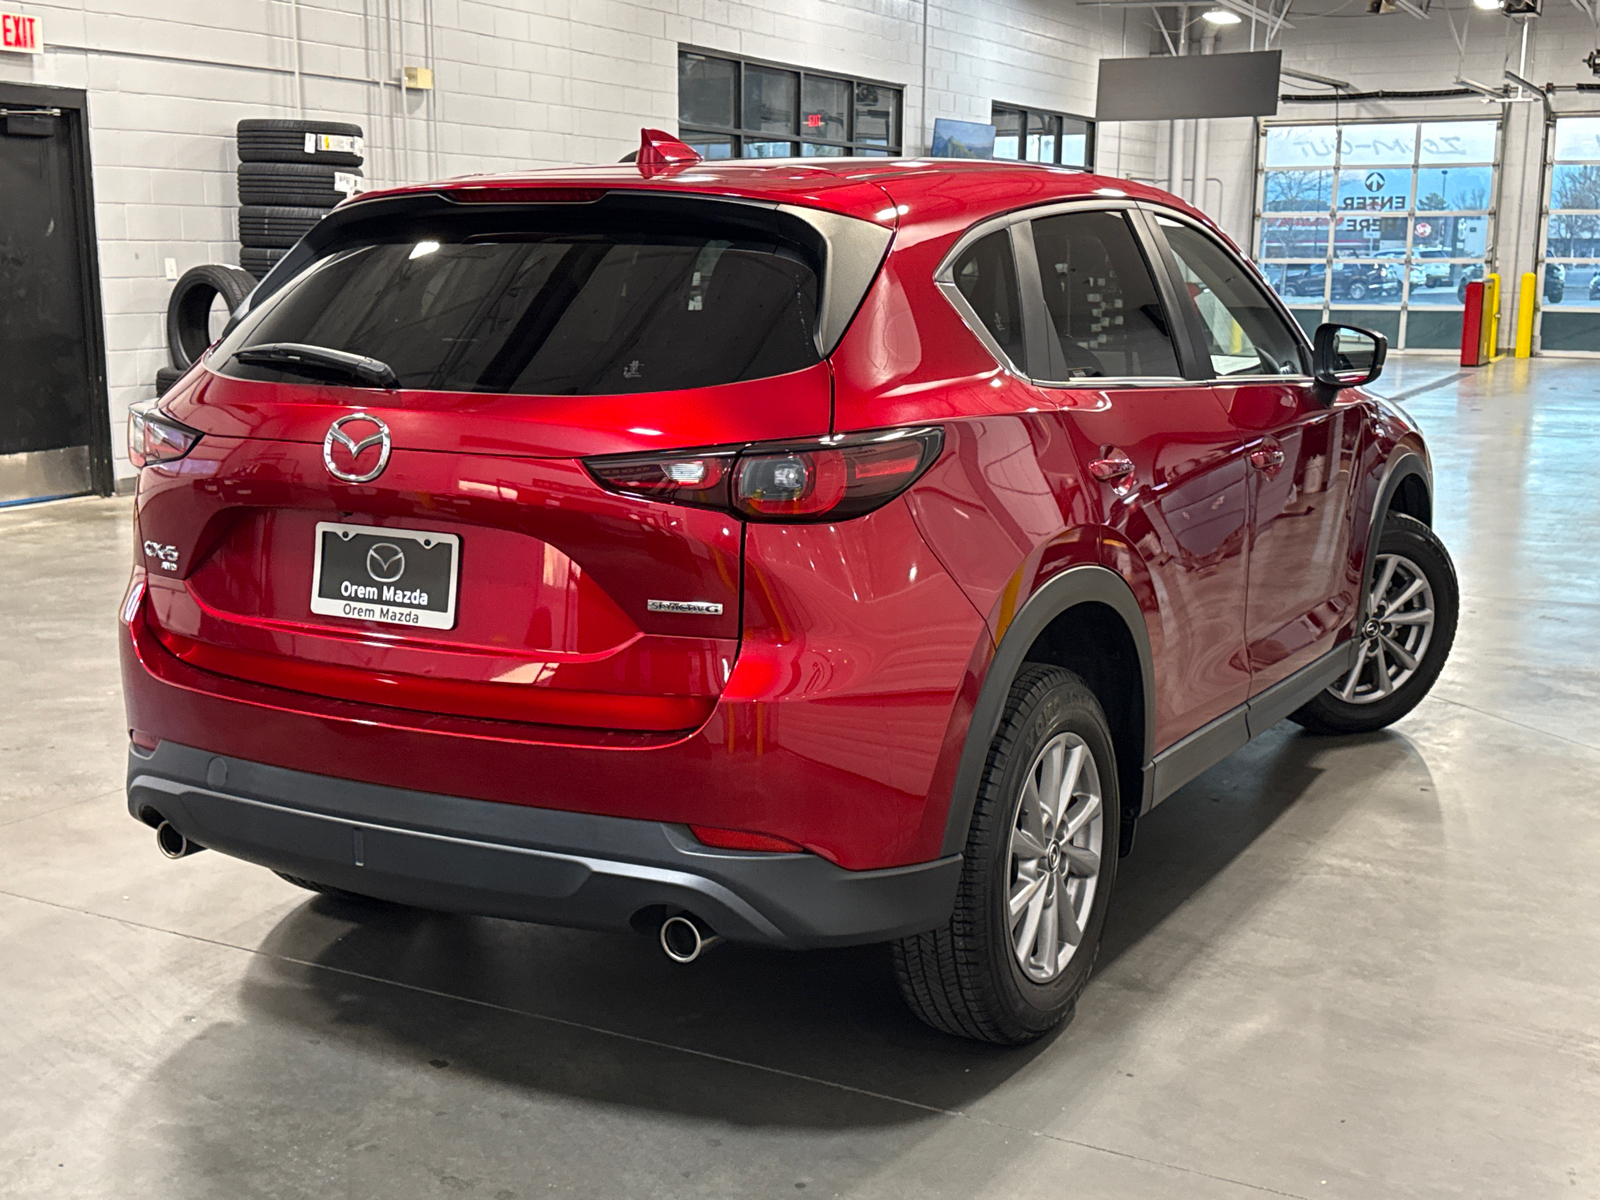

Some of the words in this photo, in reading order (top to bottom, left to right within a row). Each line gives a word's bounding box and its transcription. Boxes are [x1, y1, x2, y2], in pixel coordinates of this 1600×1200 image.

[2, 14, 36, 49] EXIT
[340, 580, 378, 600] Orem
[382, 585, 428, 606] Mazda
[343, 603, 375, 619] Orem
[379, 607, 419, 624] Mazda
